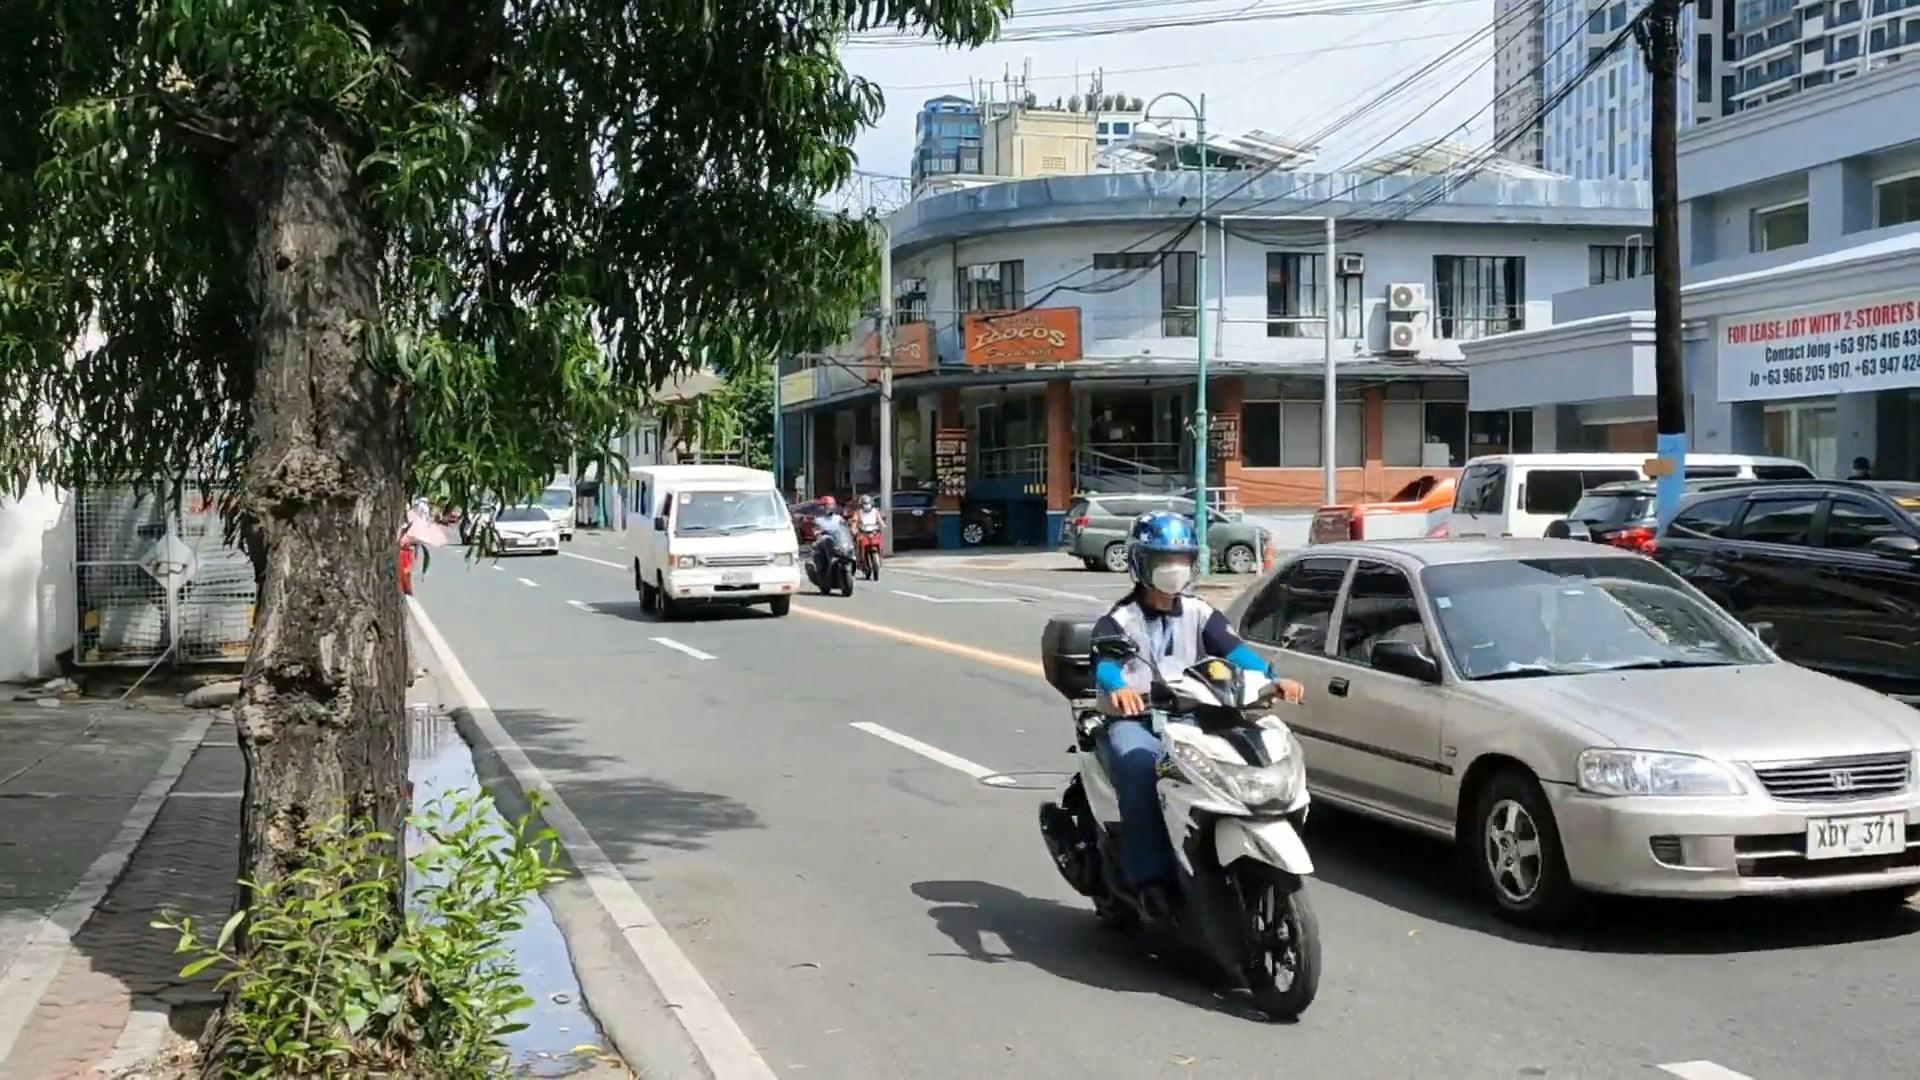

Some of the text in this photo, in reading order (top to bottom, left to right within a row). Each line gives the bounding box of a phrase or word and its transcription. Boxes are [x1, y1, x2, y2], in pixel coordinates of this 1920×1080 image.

[1727, 325, 1748, 344] FOR
[1786, 318, 1806, 338] LOT
[1808, 312, 1841, 335] WITH
[1843, 301, 1914, 330] 2-STOREYS
[1765, 345, 1805, 363] Contact
[1832, 337, 1854, 354] +63
[1856, 334, 1878, 352] 975
[1880, 330, 1901, 349] 416
[1749, 371, 1760, 387] Jo
[1762, 368, 1781, 385] +63
[1782, 366, 1803, 384] 966
[1804, 363, 1825, 382] 205
[1854, 358, 1877, 376] +63
[1879, 356, 1900, 375] 947
[1817, 820, 1896, 849] XDY 371
